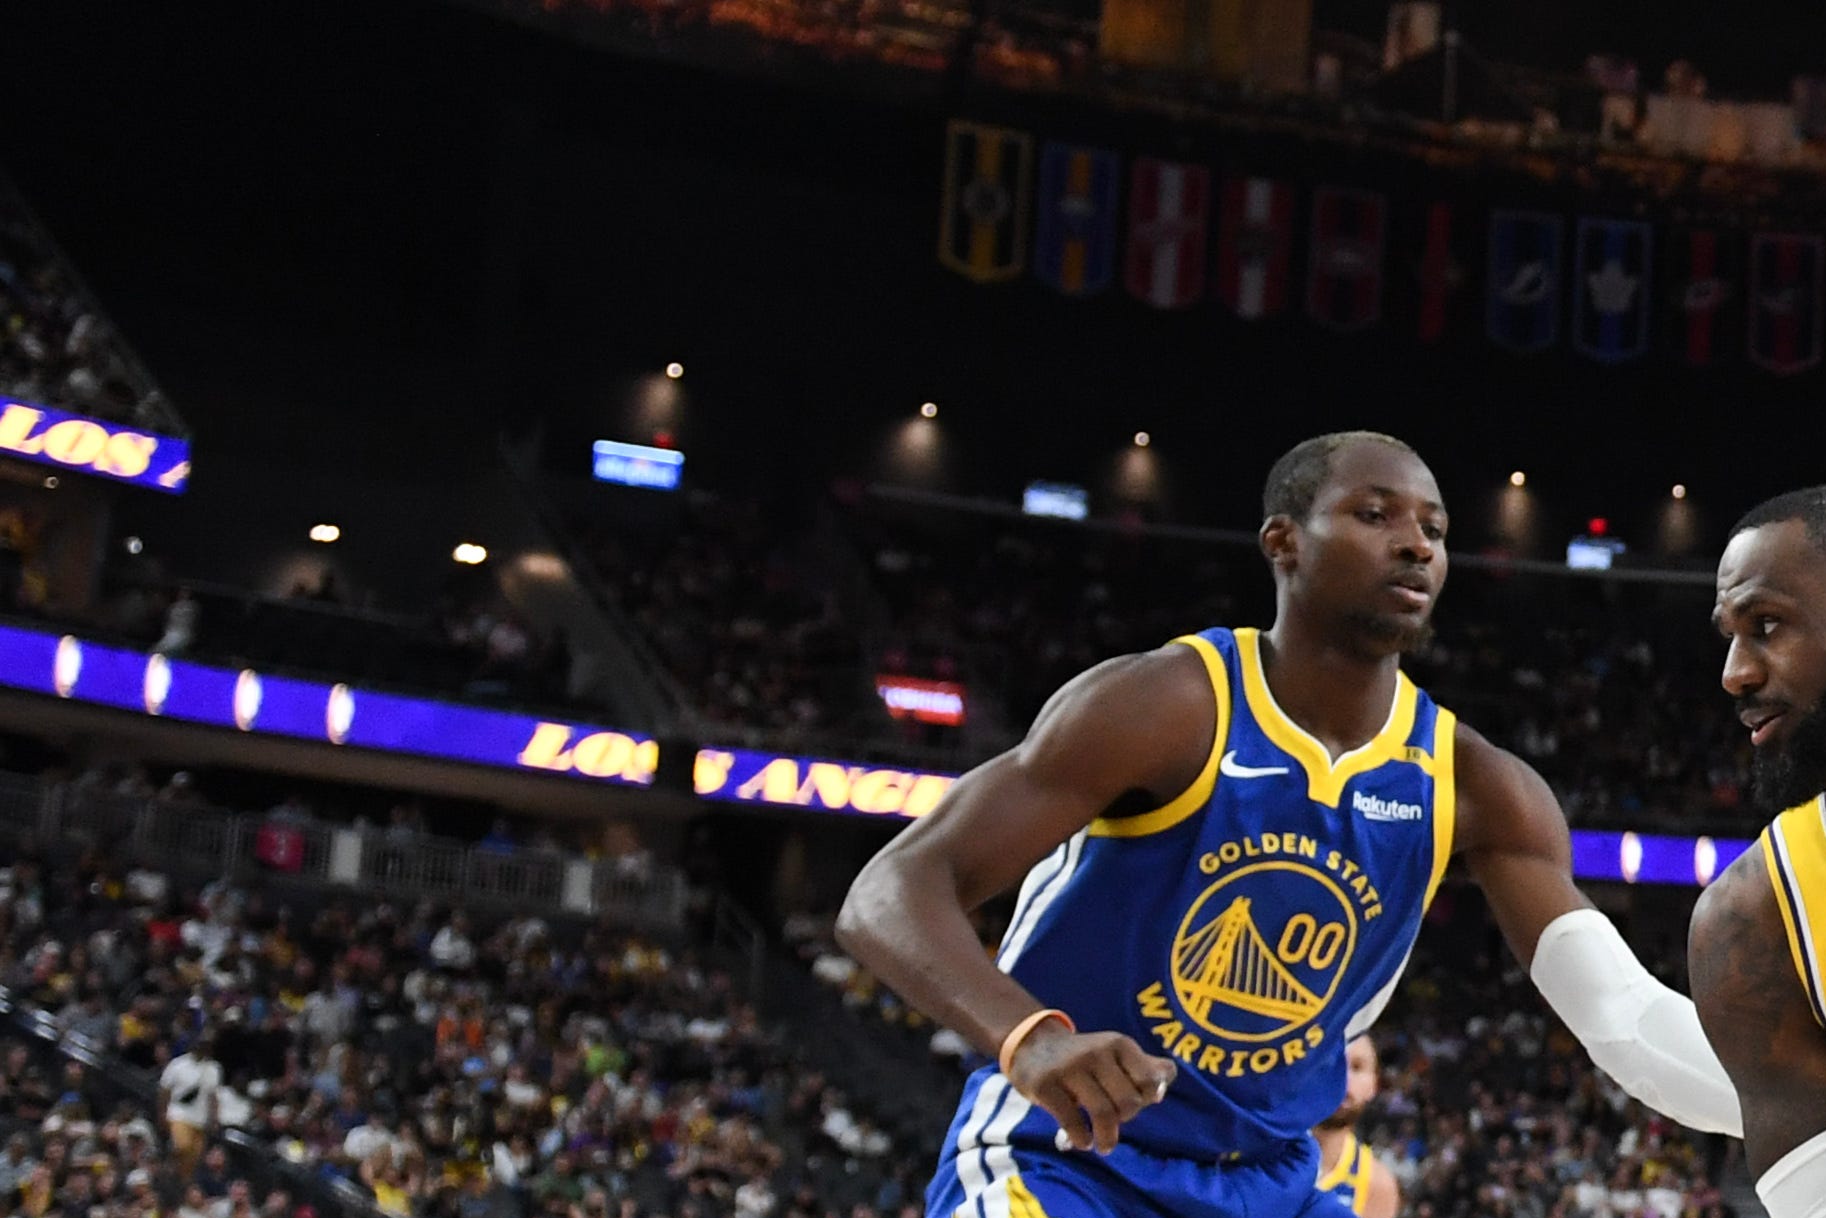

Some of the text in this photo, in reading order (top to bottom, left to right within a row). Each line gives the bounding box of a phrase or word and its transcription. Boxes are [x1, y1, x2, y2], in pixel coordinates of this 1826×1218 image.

[0, 403, 158, 477] LOS
[1353, 790, 1422, 821] Rakuten
[1199, 832, 1382, 921] GOLDEN STATE
[1277, 912, 1346, 970] 00
[1136, 980, 1324, 1078] WARRIORS
